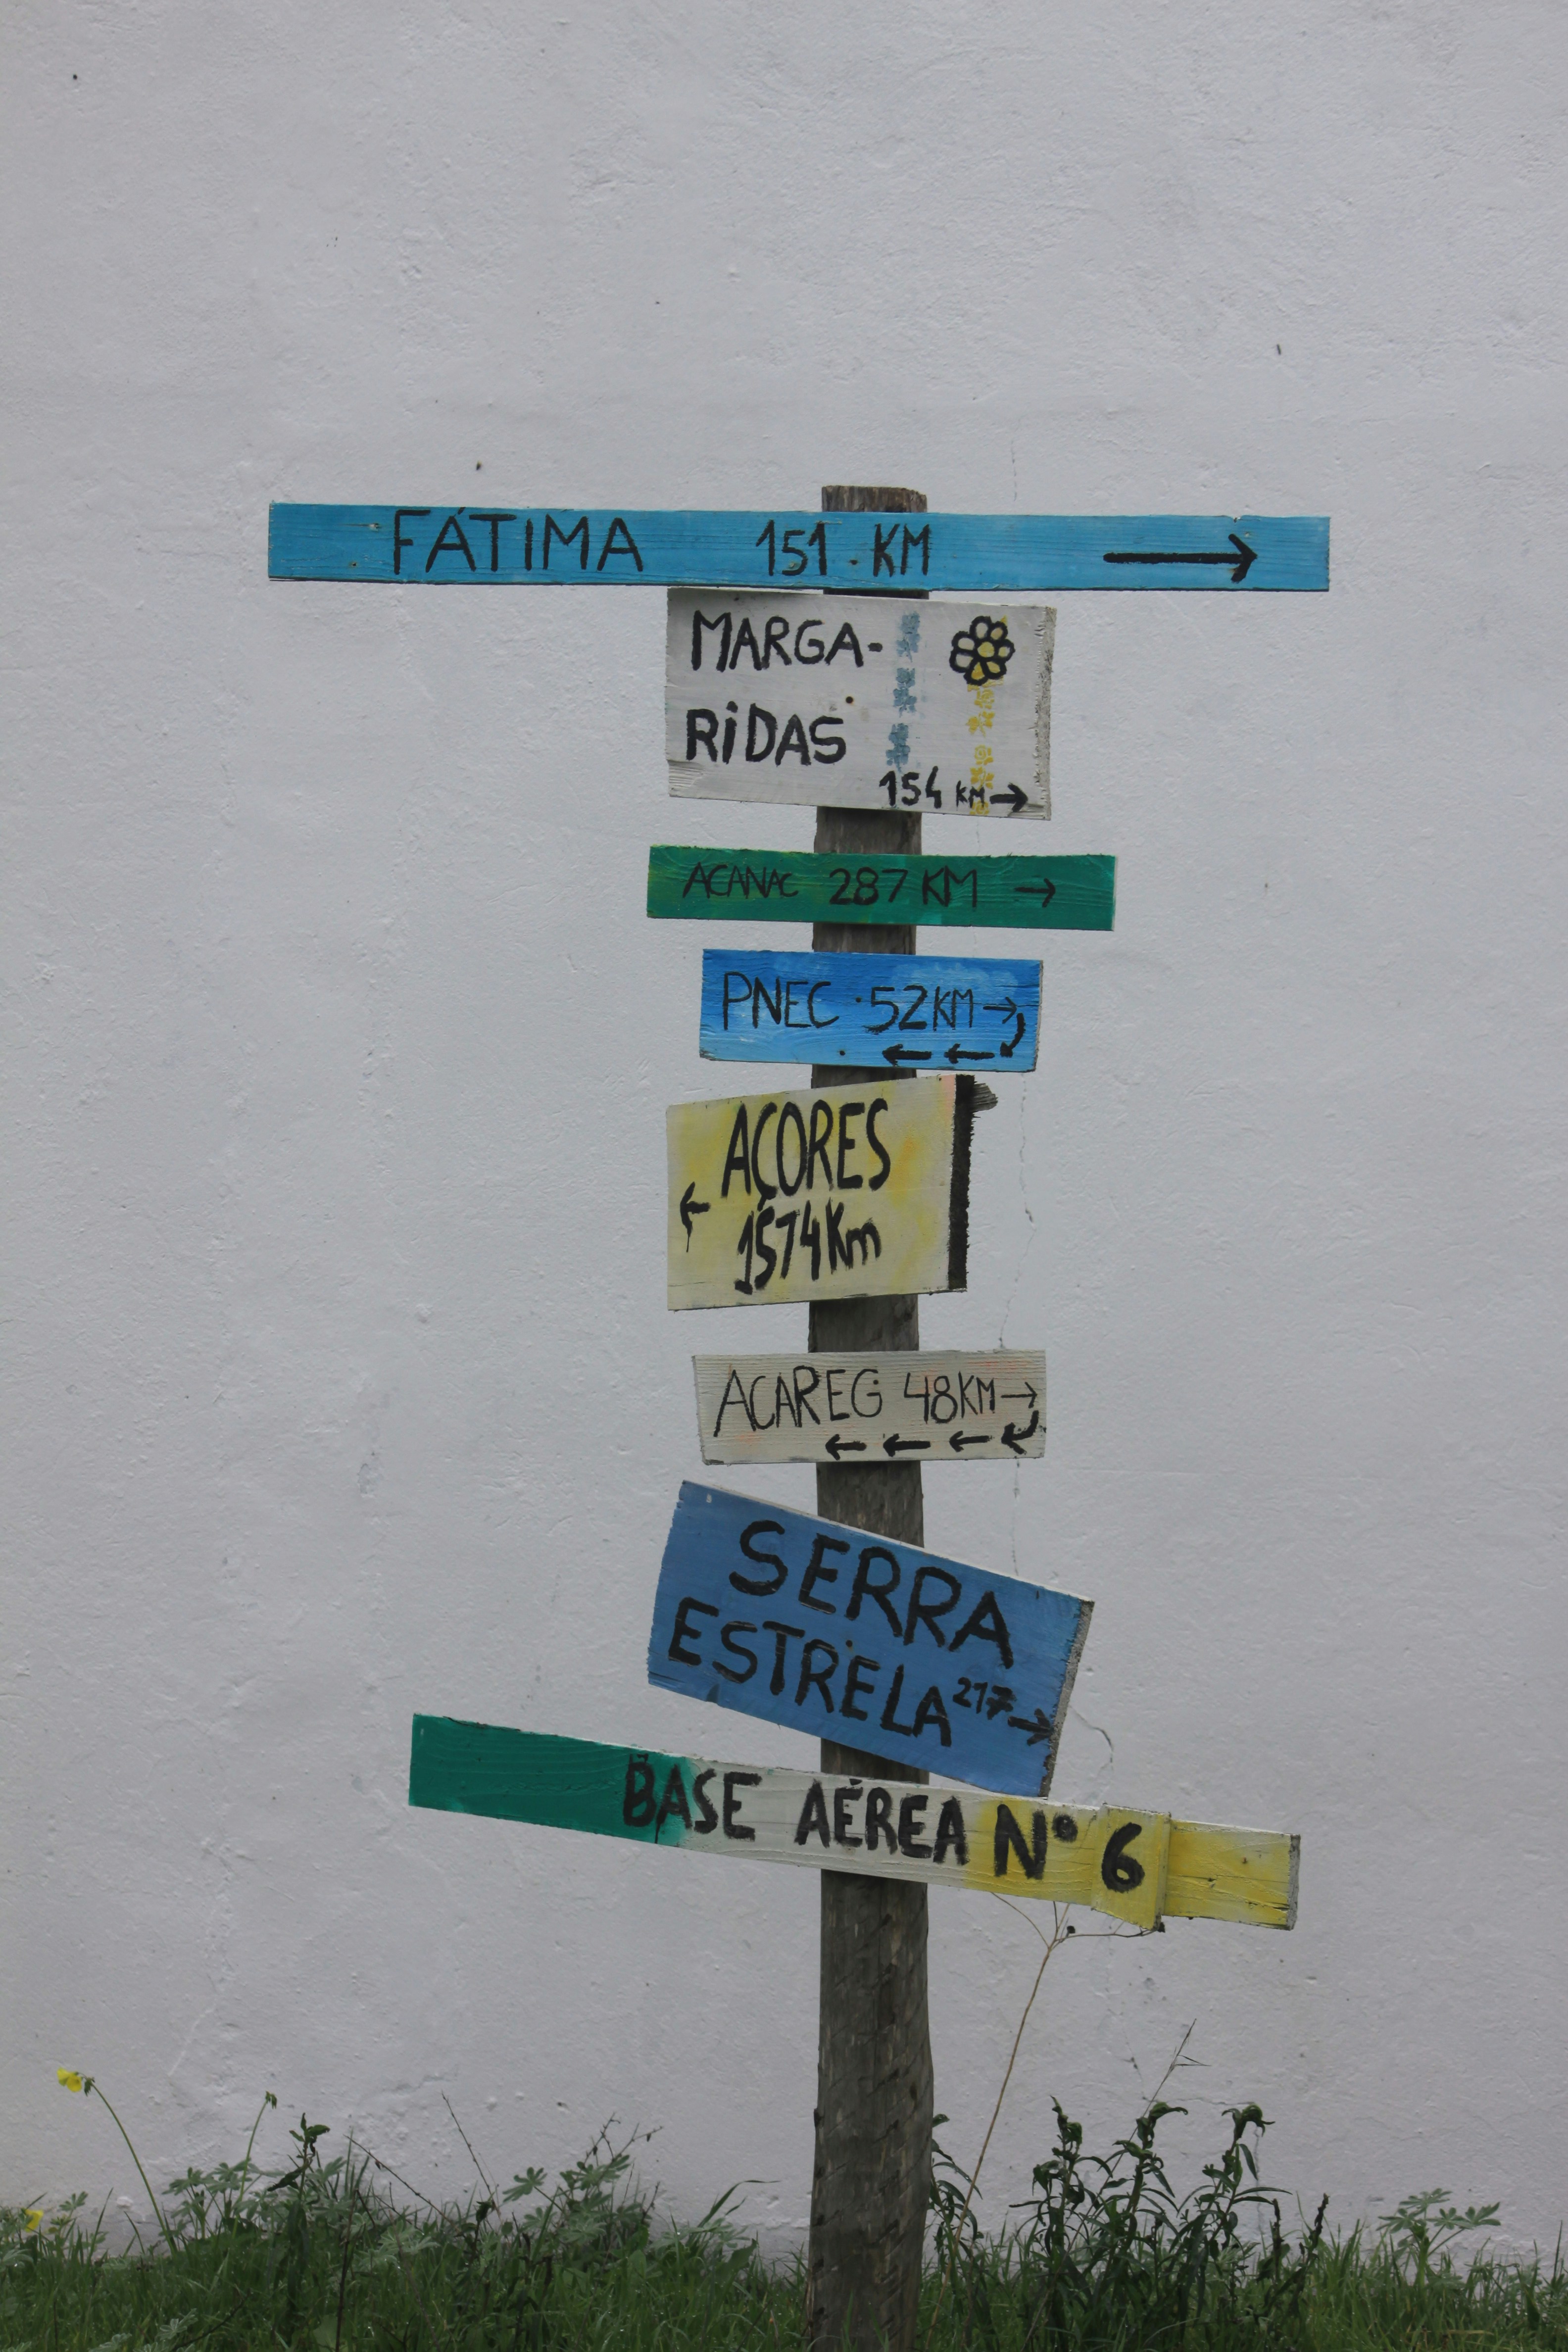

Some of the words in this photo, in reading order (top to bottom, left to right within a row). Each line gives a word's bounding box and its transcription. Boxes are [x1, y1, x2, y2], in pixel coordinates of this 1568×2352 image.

[394, 507, 644, 575] FÁTIMA
[755, 519, 828, 577] 151
[873, 523, 930, 576] KM
[691, 610, 883, 672] MARGA-
[879, 766, 942, 809] 154
[683, 862, 799, 899] ACANAC
[829, 867, 909, 906] 287
[922, 866, 978, 909] KM
[723, 972, 840, 1030] PNEC
[721, 1098, 891, 1211] AÇORES
[714, 1365, 882, 1437] ACAREG
[729, 1520, 1013, 1669] SERRA
[668, 1596, 952, 1747] ESTRELA
[623, 1754, 762, 1844] BASE
[794, 1778, 970, 1865] AÉREA
[1101, 1822, 1145, 1893] 6
